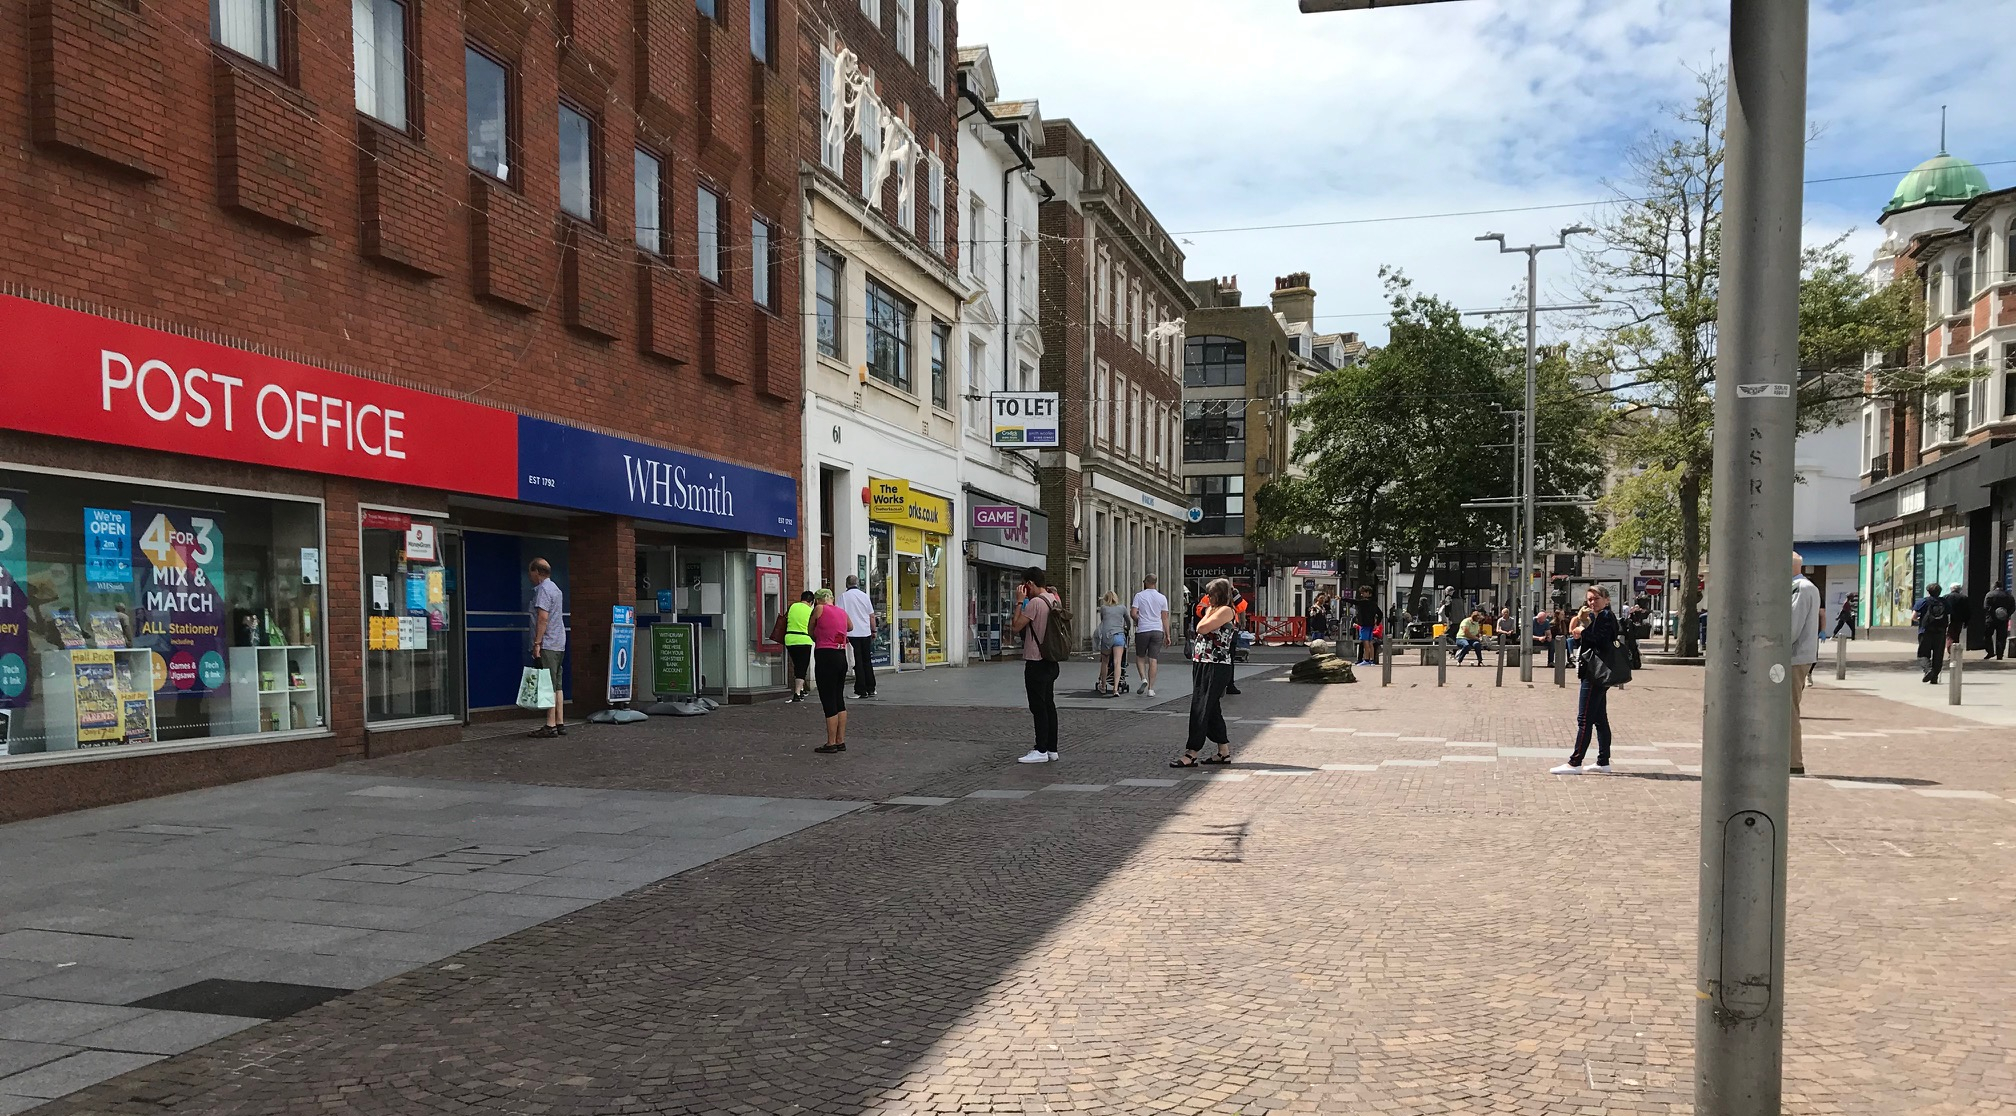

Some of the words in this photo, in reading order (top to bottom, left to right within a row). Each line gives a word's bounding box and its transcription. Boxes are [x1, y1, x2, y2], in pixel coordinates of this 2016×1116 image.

[101, 349, 243, 432] POST
[256, 384, 406, 459] OFFICE
[996, 399, 1019, 416] TO
[1025, 399, 1054, 416] LET
[832, 425, 841, 444] 61
[528, 475, 540, 485] EST
[542, 477, 556, 488] 1792
[623, 454, 735, 517] WHSmith
[880, 484, 898, 493] The
[873, 494, 904, 504] Works
[93, 510, 122, 522] We're
[977, 511, 1014, 523] GAME
[90, 521, 126, 536] OPEN
[139, 513, 171, 562] 4
[169, 531, 194, 546] FOR
[190, 517, 214, 564] 3
[152, 566, 188, 586] MIX
[193, 567, 206, 587] &
[1184, 566, 1226, 578] Creperie
[147, 591, 213, 613] MATCH
[142, 621, 166, 634] ALL
[169, 623, 219, 636] Stationery
[169, 662, 191, 670] Games
[204, 661, 219, 669] Tech
